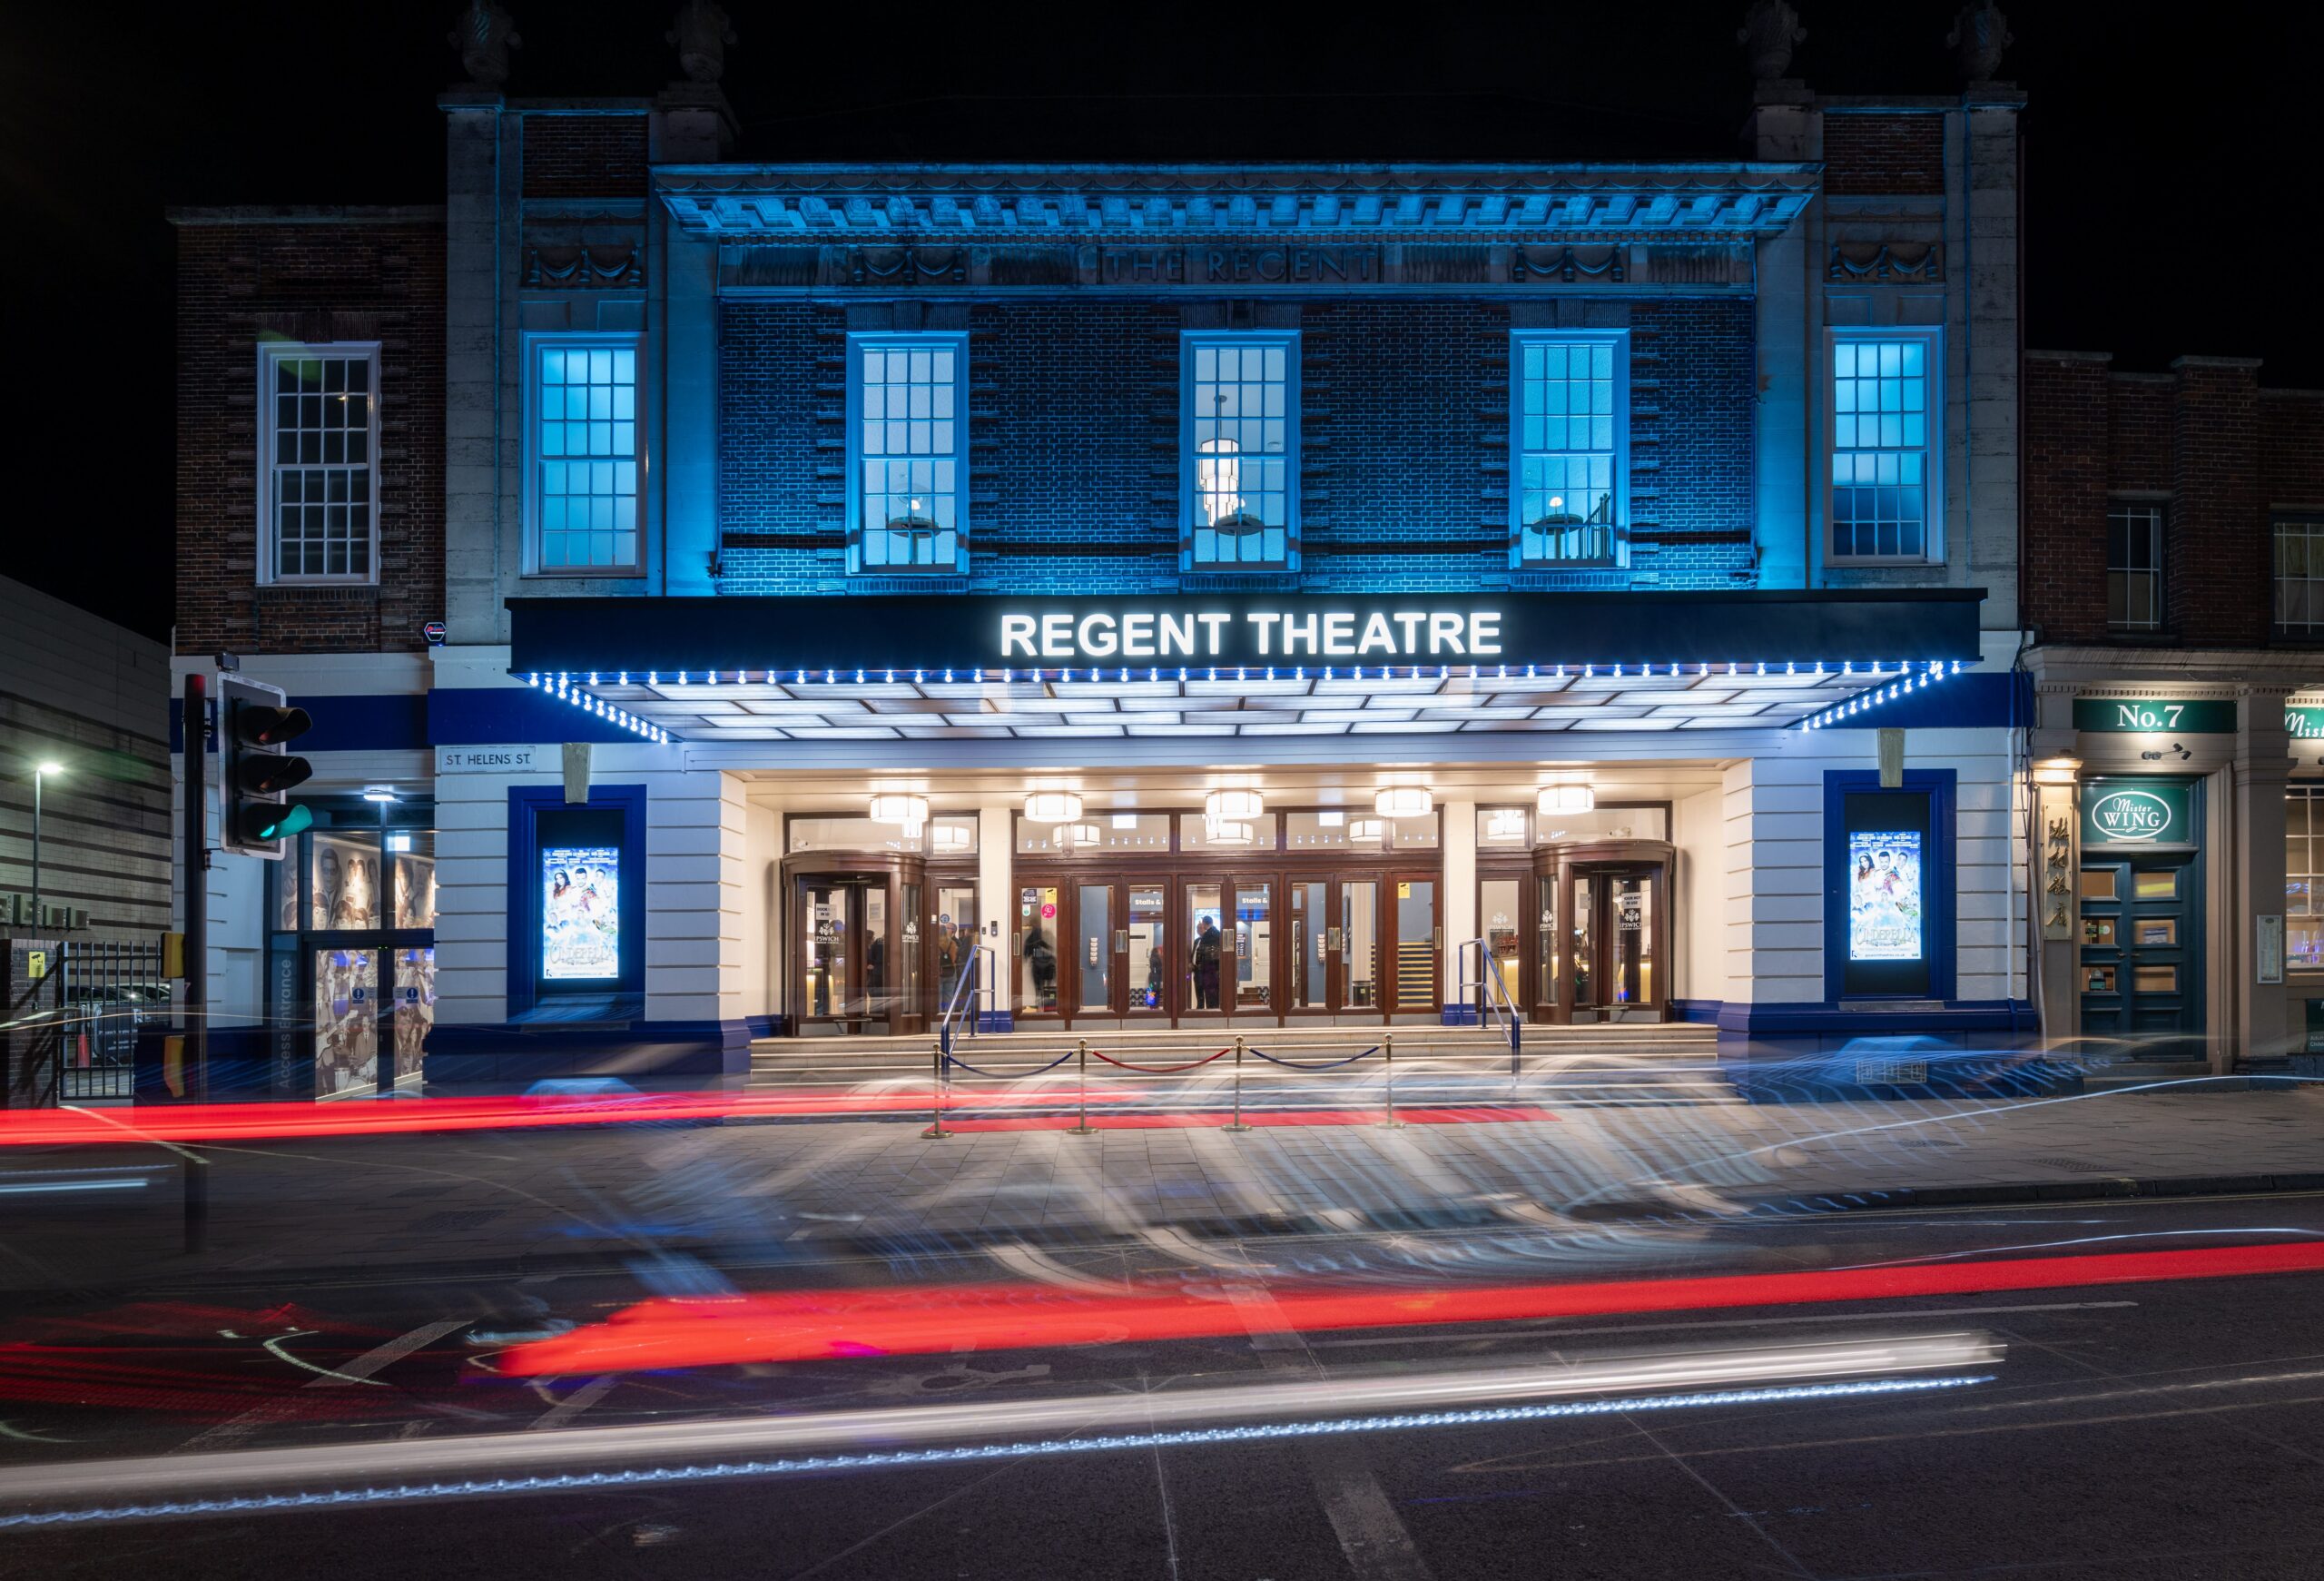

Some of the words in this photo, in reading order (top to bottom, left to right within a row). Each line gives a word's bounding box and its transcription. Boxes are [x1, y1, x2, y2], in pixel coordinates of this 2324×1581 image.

[1105, 249, 1183, 282] THE
[1207, 249, 1376, 282] REGENT
[1000, 613, 1231, 657] REGENT
[1246, 612, 1502, 655] THEATRE
[2116, 705, 2185, 728] No.7
[446, 755, 462, 766] ST.
[468, 754, 511, 765] HELENS
[516, 753, 531, 764] ST.
[2112, 797, 2152, 812] Mister
[2103, 812, 2161, 827] WING
[279, 958, 291, 1029] Entrance
[278, 1033, 291, 1090] Access
